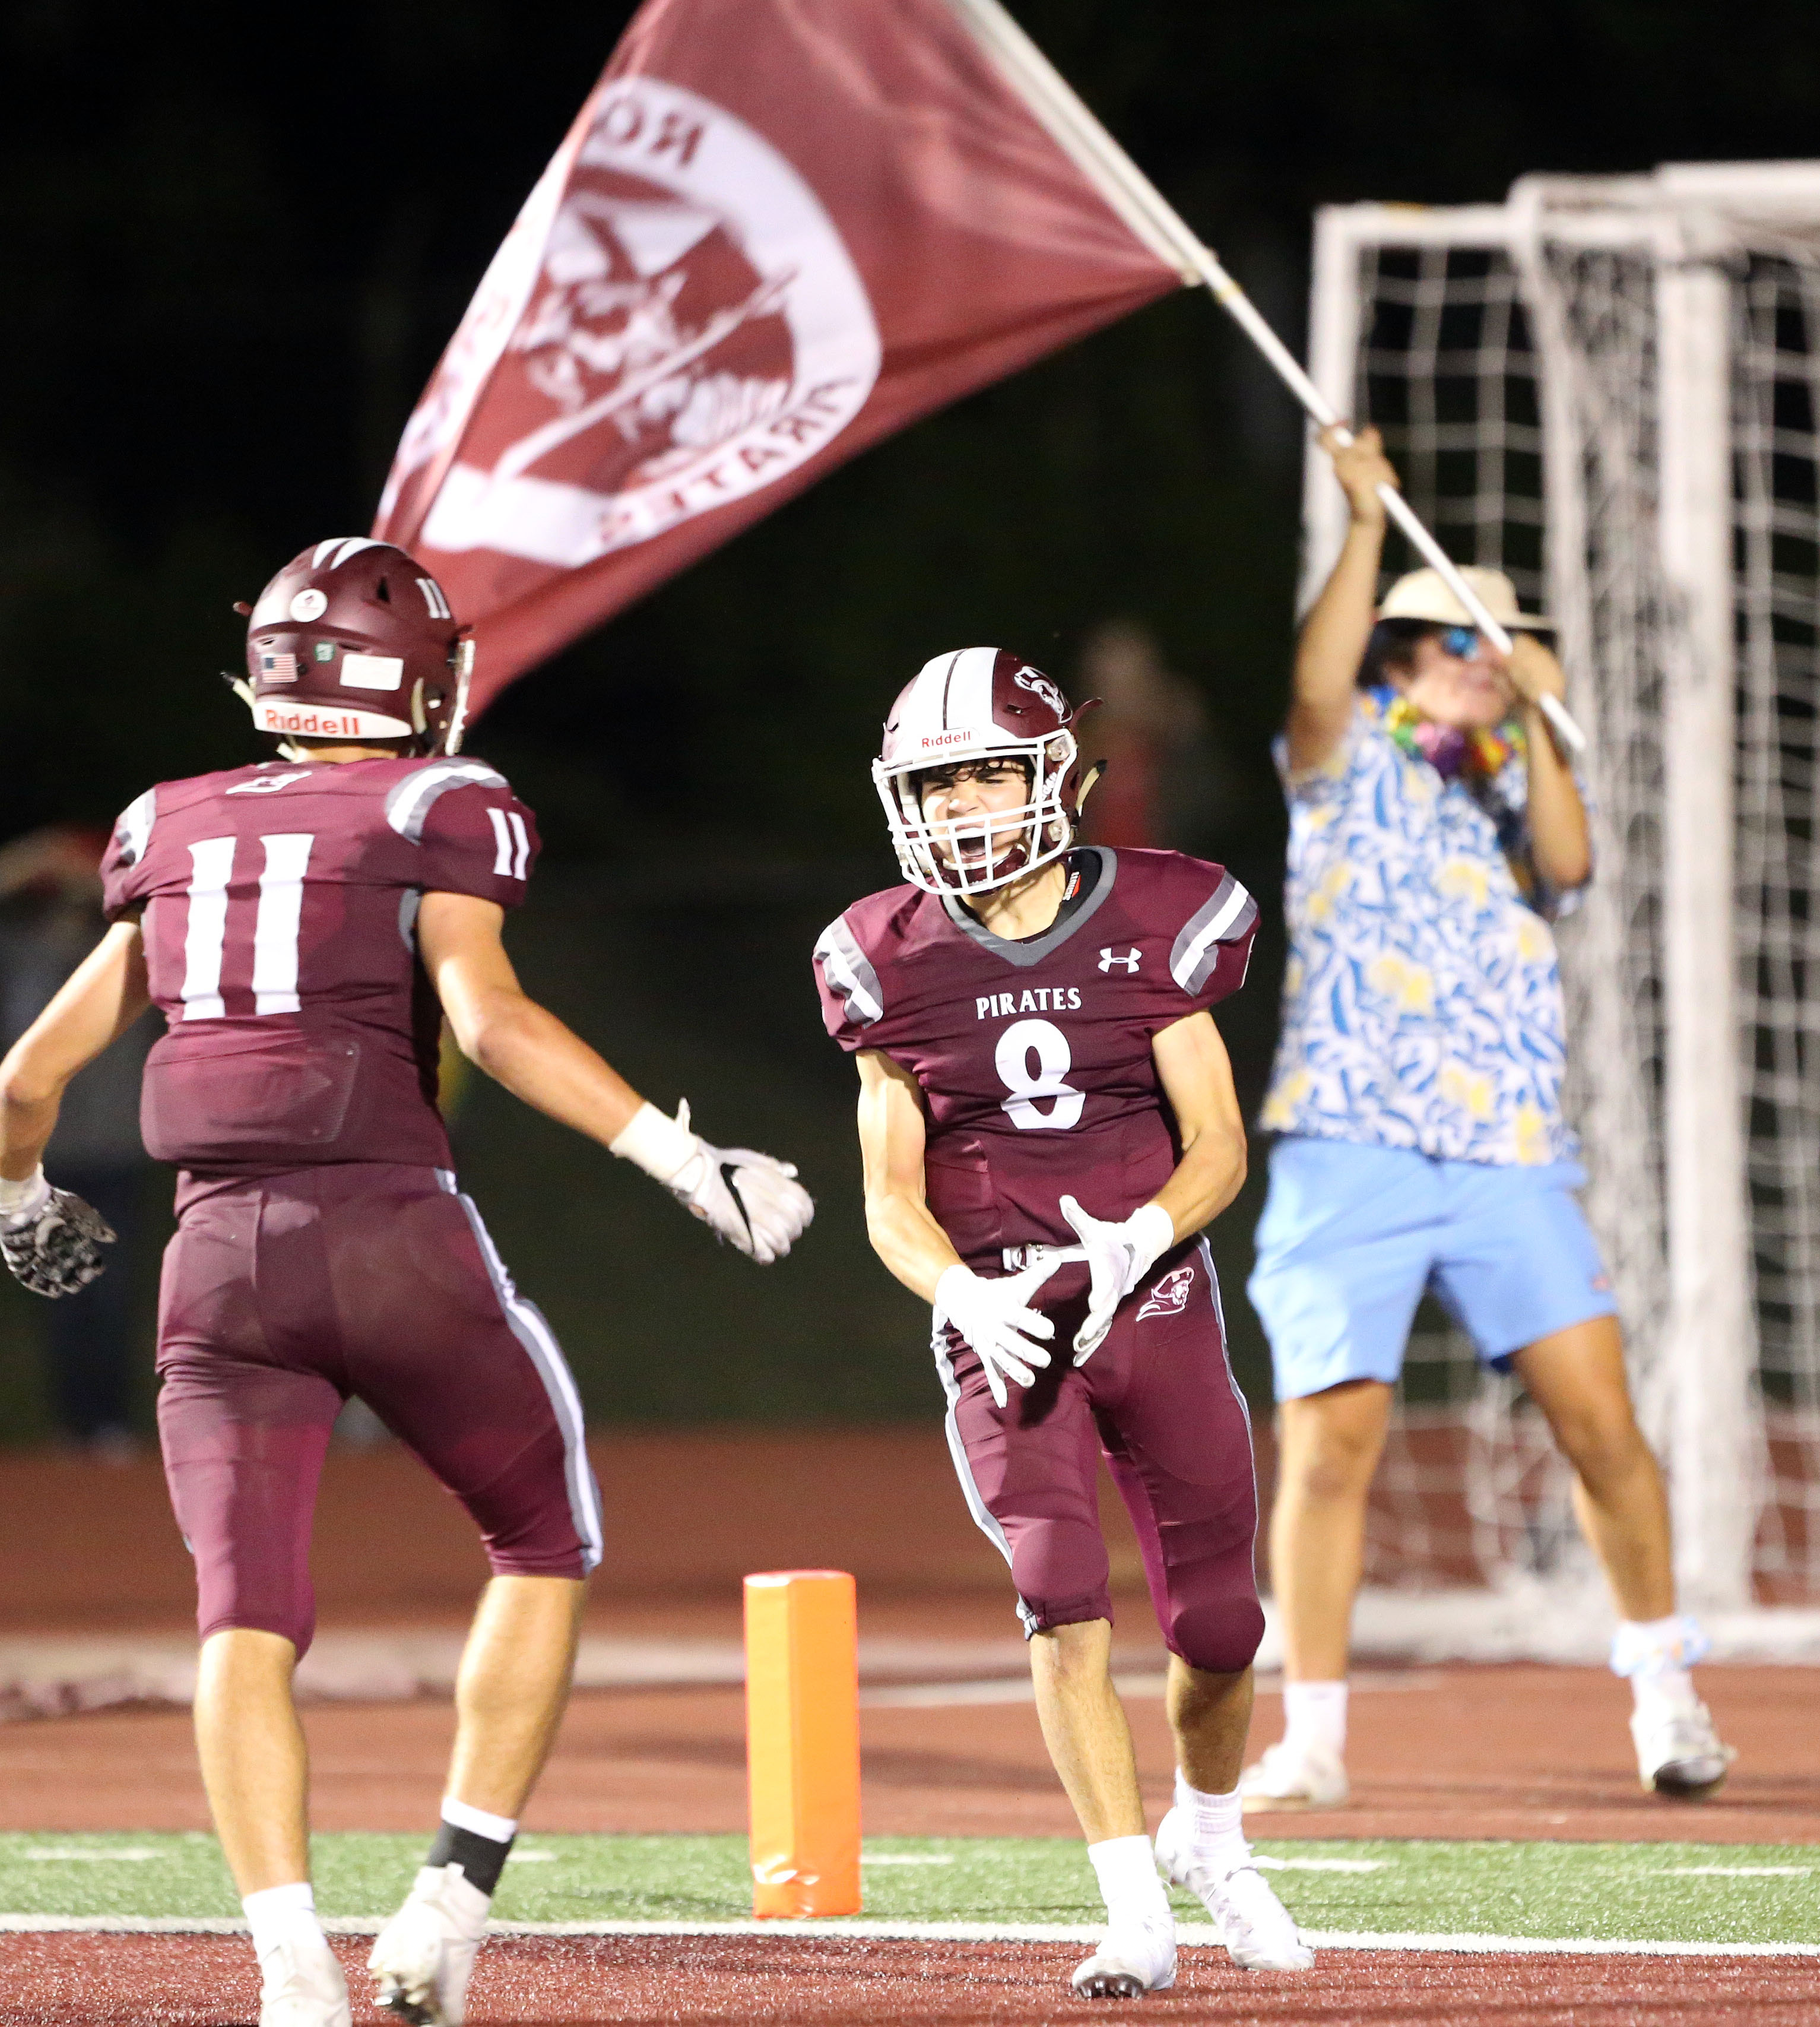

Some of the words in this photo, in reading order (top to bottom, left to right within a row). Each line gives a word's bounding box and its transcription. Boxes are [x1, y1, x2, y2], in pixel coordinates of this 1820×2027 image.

[416, 578, 451, 619] 11
[265, 709, 360, 735] Riddell
[921, 731, 971, 748] Riddell
[486, 807, 530, 881] 11
[180, 833, 315, 1021] 11
[975, 987, 1082, 1020] PIRATES
[994, 1019, 1086, 1130] 8
